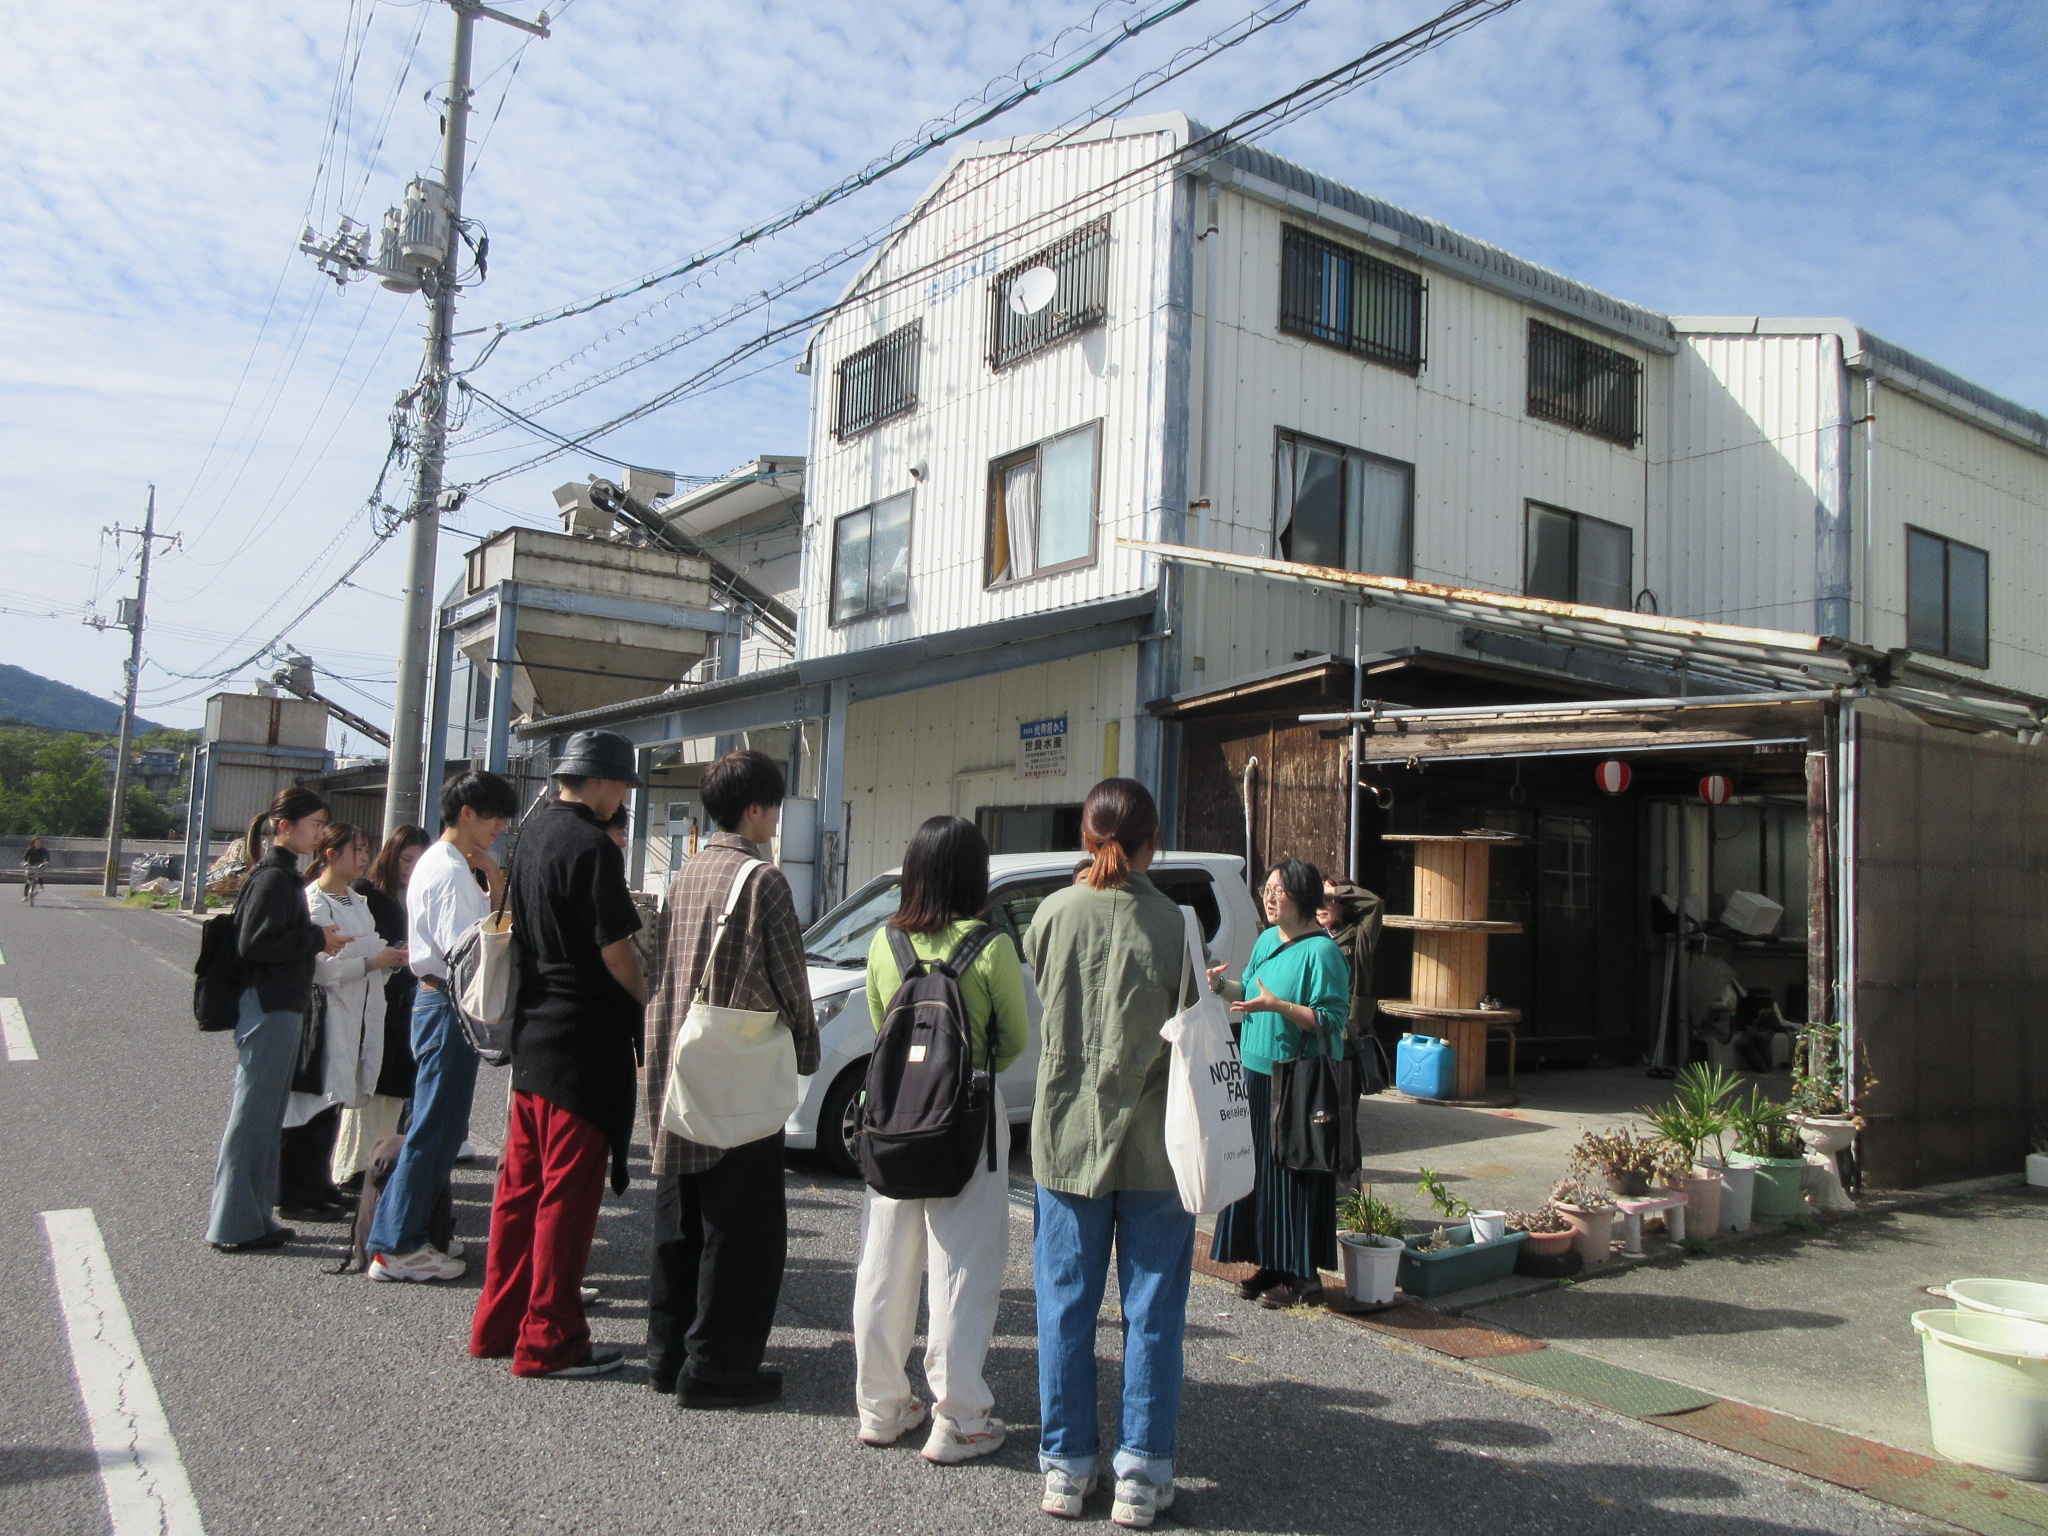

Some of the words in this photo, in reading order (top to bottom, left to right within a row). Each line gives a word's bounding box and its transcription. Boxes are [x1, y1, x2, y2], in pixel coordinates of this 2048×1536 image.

[1025, 736, 1063, 752] 世良水産
[1209, 1060, 1242, 1085] NOR
